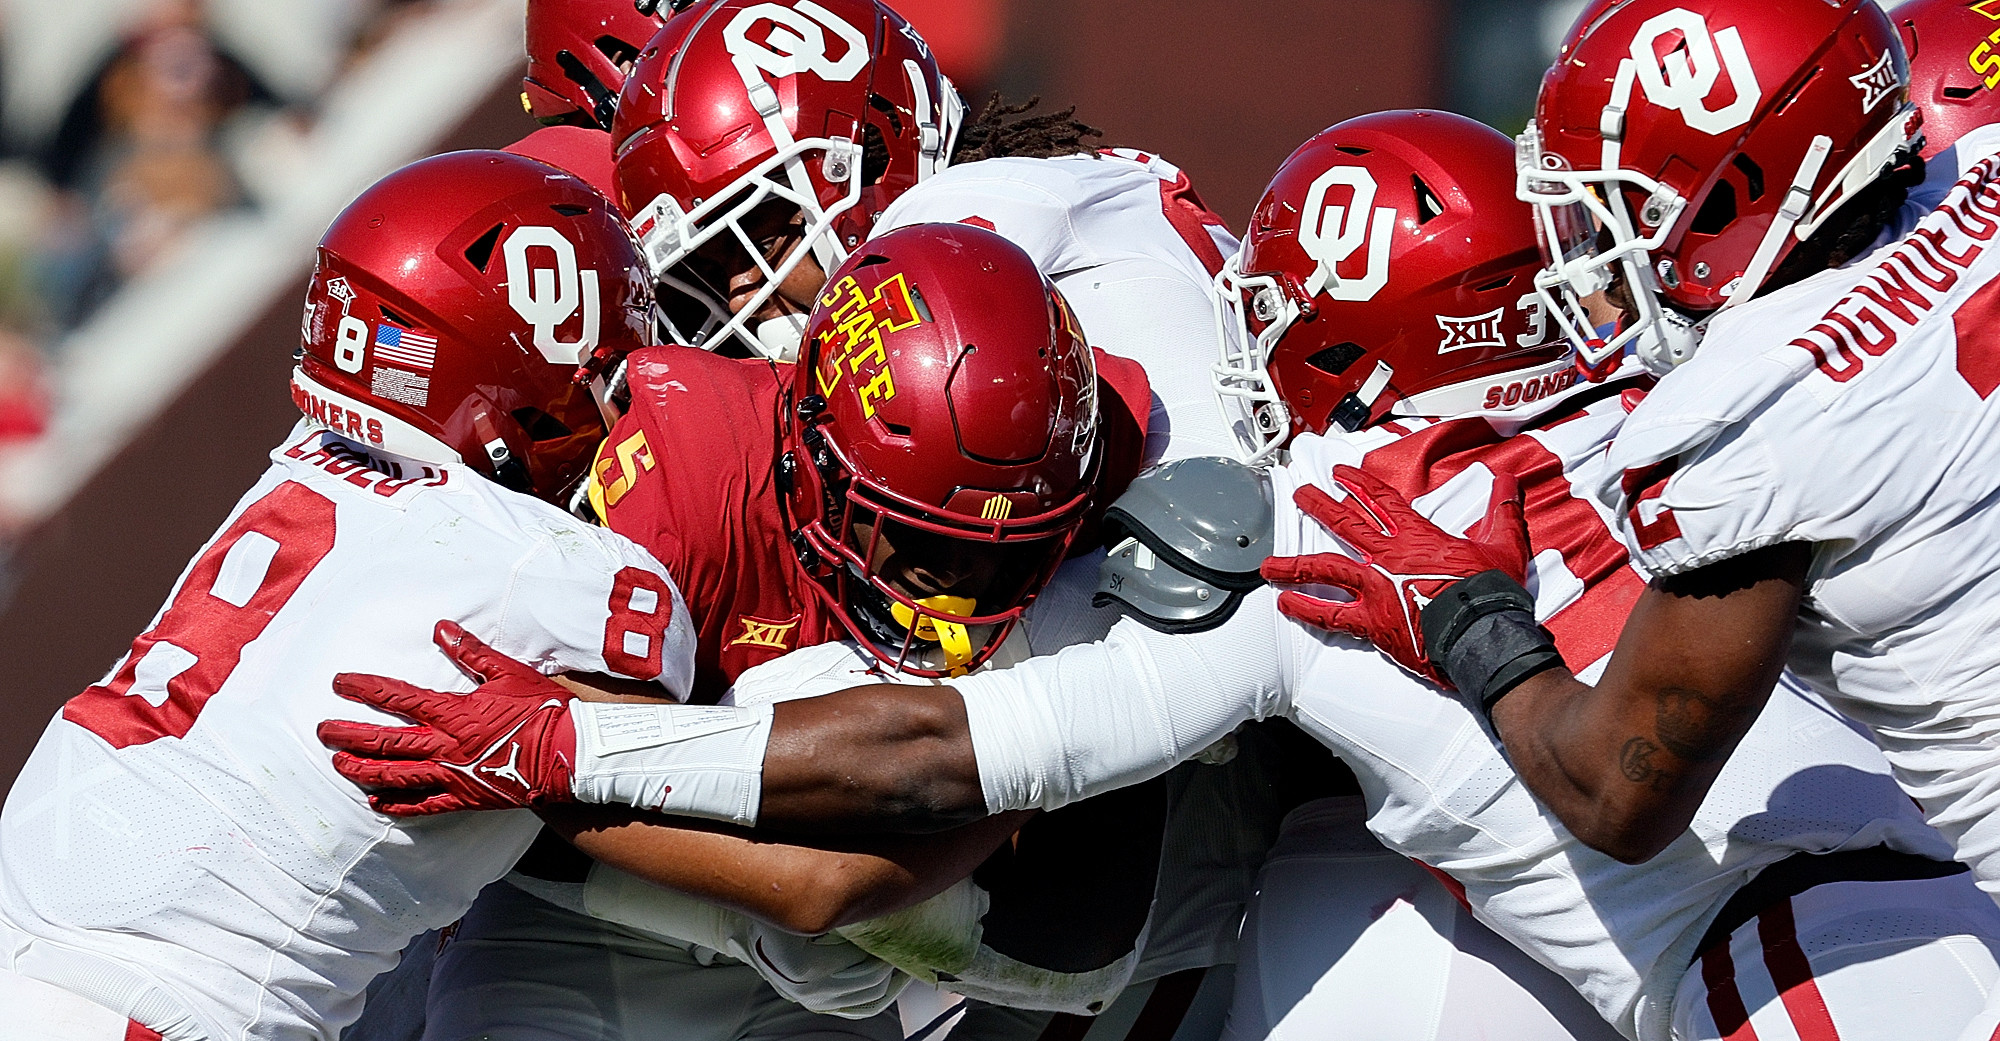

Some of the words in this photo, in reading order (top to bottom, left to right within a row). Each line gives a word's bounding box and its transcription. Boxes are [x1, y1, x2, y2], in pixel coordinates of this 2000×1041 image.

[722, 0, 870, 81] OU
[1629, 7, 1762, 136] OU
[1298, 165, 1398, 301] OU
[334, 315, 369, 374] 8
[503, 226, 600, 364] OU
[820, 275, 896, 420] STATE
[1483, 366, 1578, 409] SOONER
[596, 429, 656, 506] 5
[62, 479, 338, 751] 8
[601, 565, 673, 681] 8
[730, 617, 798, 650] XII
